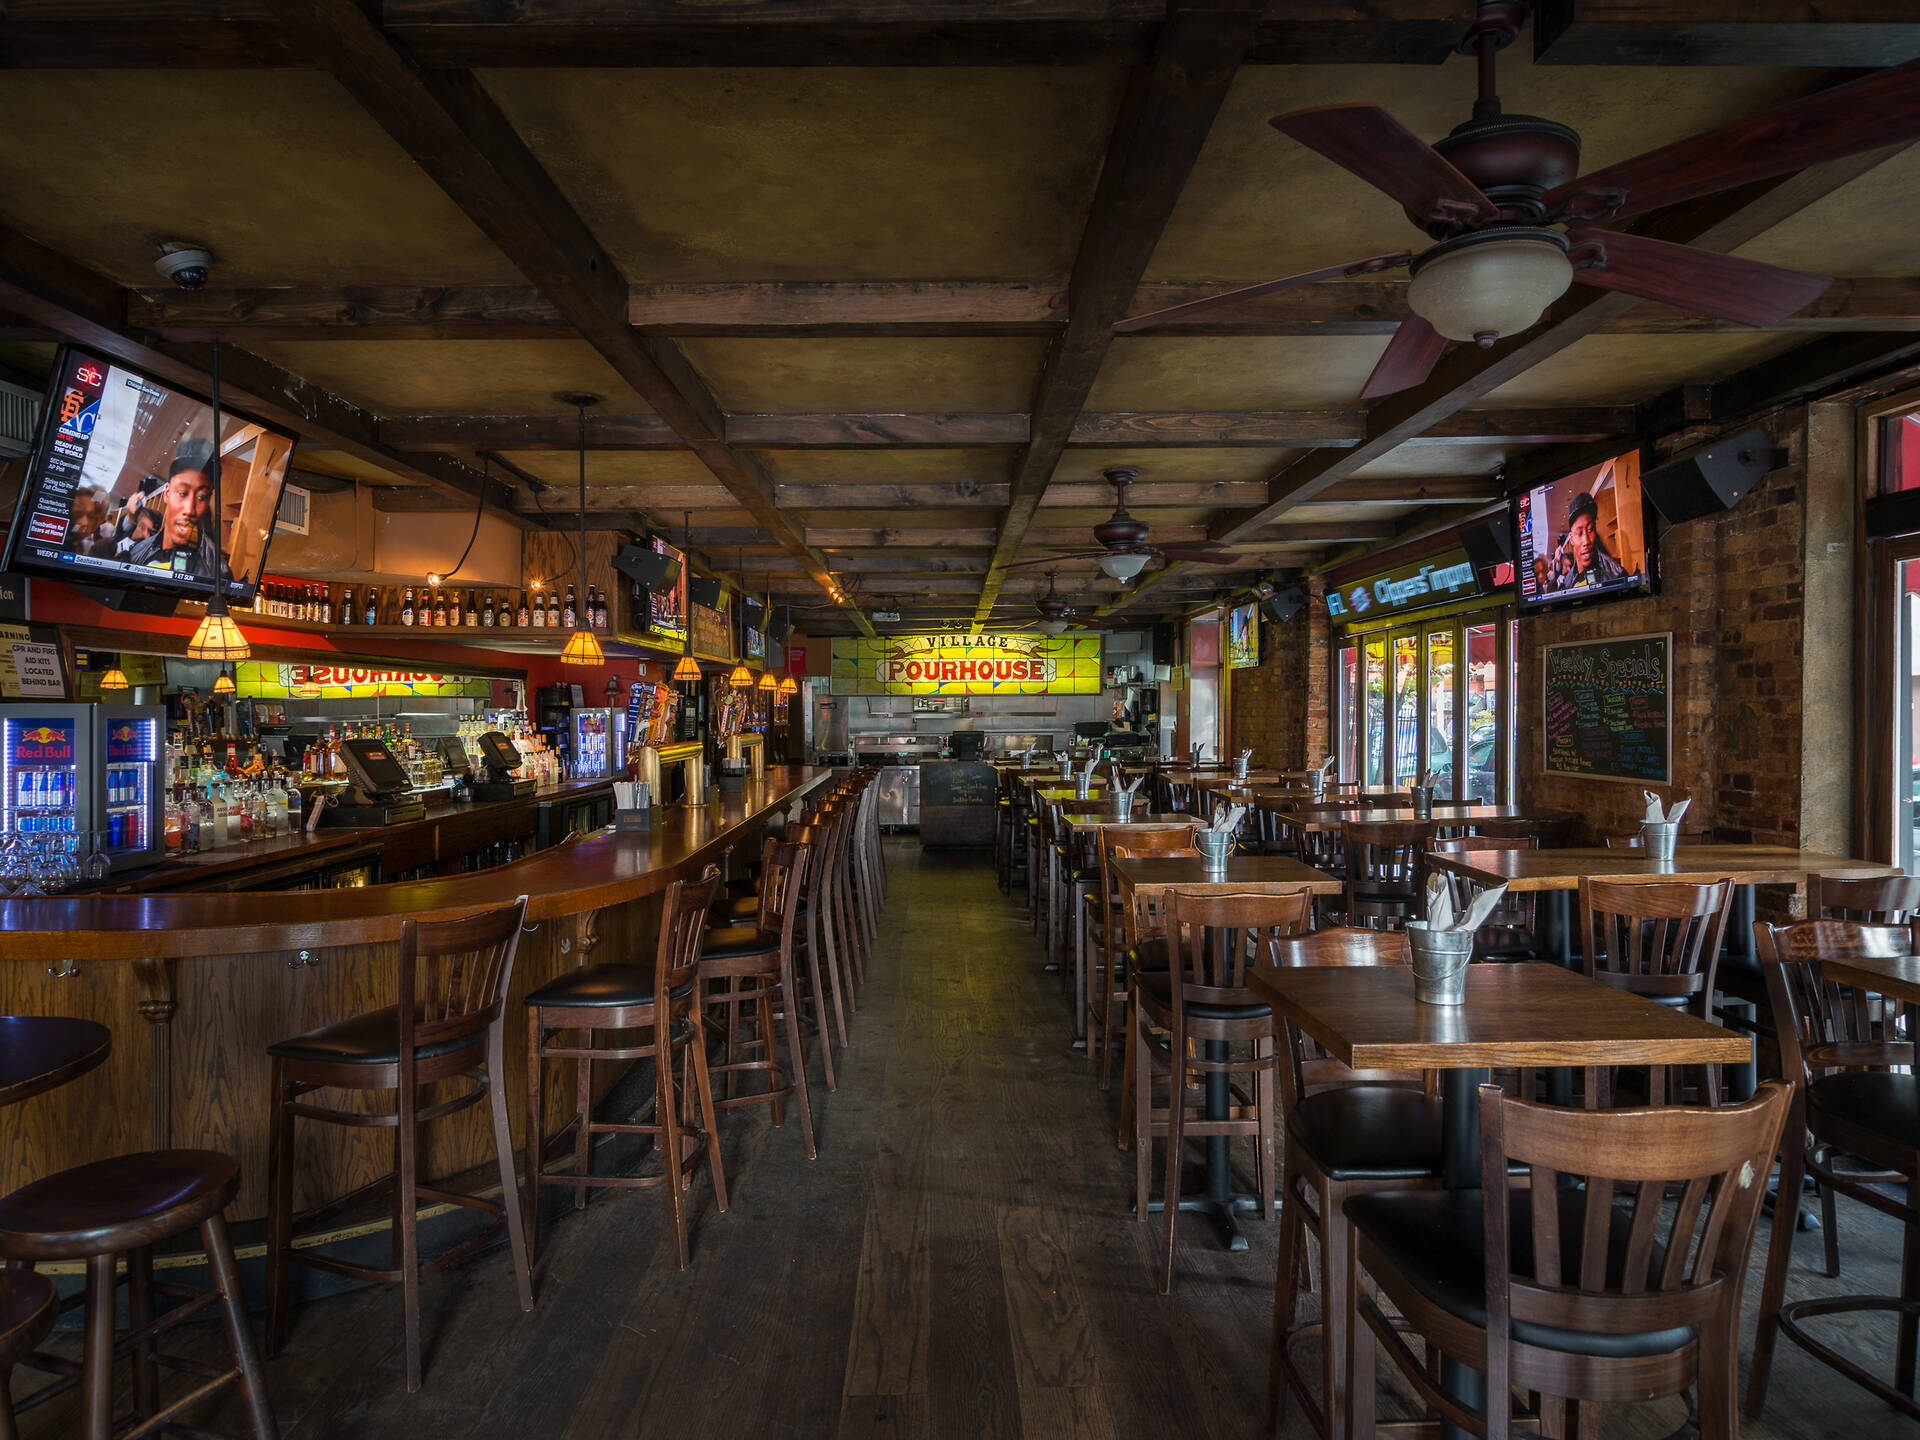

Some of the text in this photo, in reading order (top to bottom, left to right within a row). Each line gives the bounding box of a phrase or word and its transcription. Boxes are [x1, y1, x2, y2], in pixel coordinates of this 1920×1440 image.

[76, 367, 102, 387] SC
[54, 445, 83, 459] THE WORLD
[55, 440, 84, 453] READY FOR
[36, 549, 52, 558] WEEK
[76, 556, 103, 566] Seahawks
[926, 636, 1008, 648] VILLAGE
[27, 646, 41, 654] AND
[25, 657, 37, 665] AID
[1549, 643, 1661, 689] Weekly Specials
[24, 667, 54, 676] LOCATED
[888, 660, 1046, 681] POURHOUSE
[22, 677, 61, 687] BEHIND BAR
[17, 745, 71, 758] Red Bull
[108, 744, 126, 756] Red
